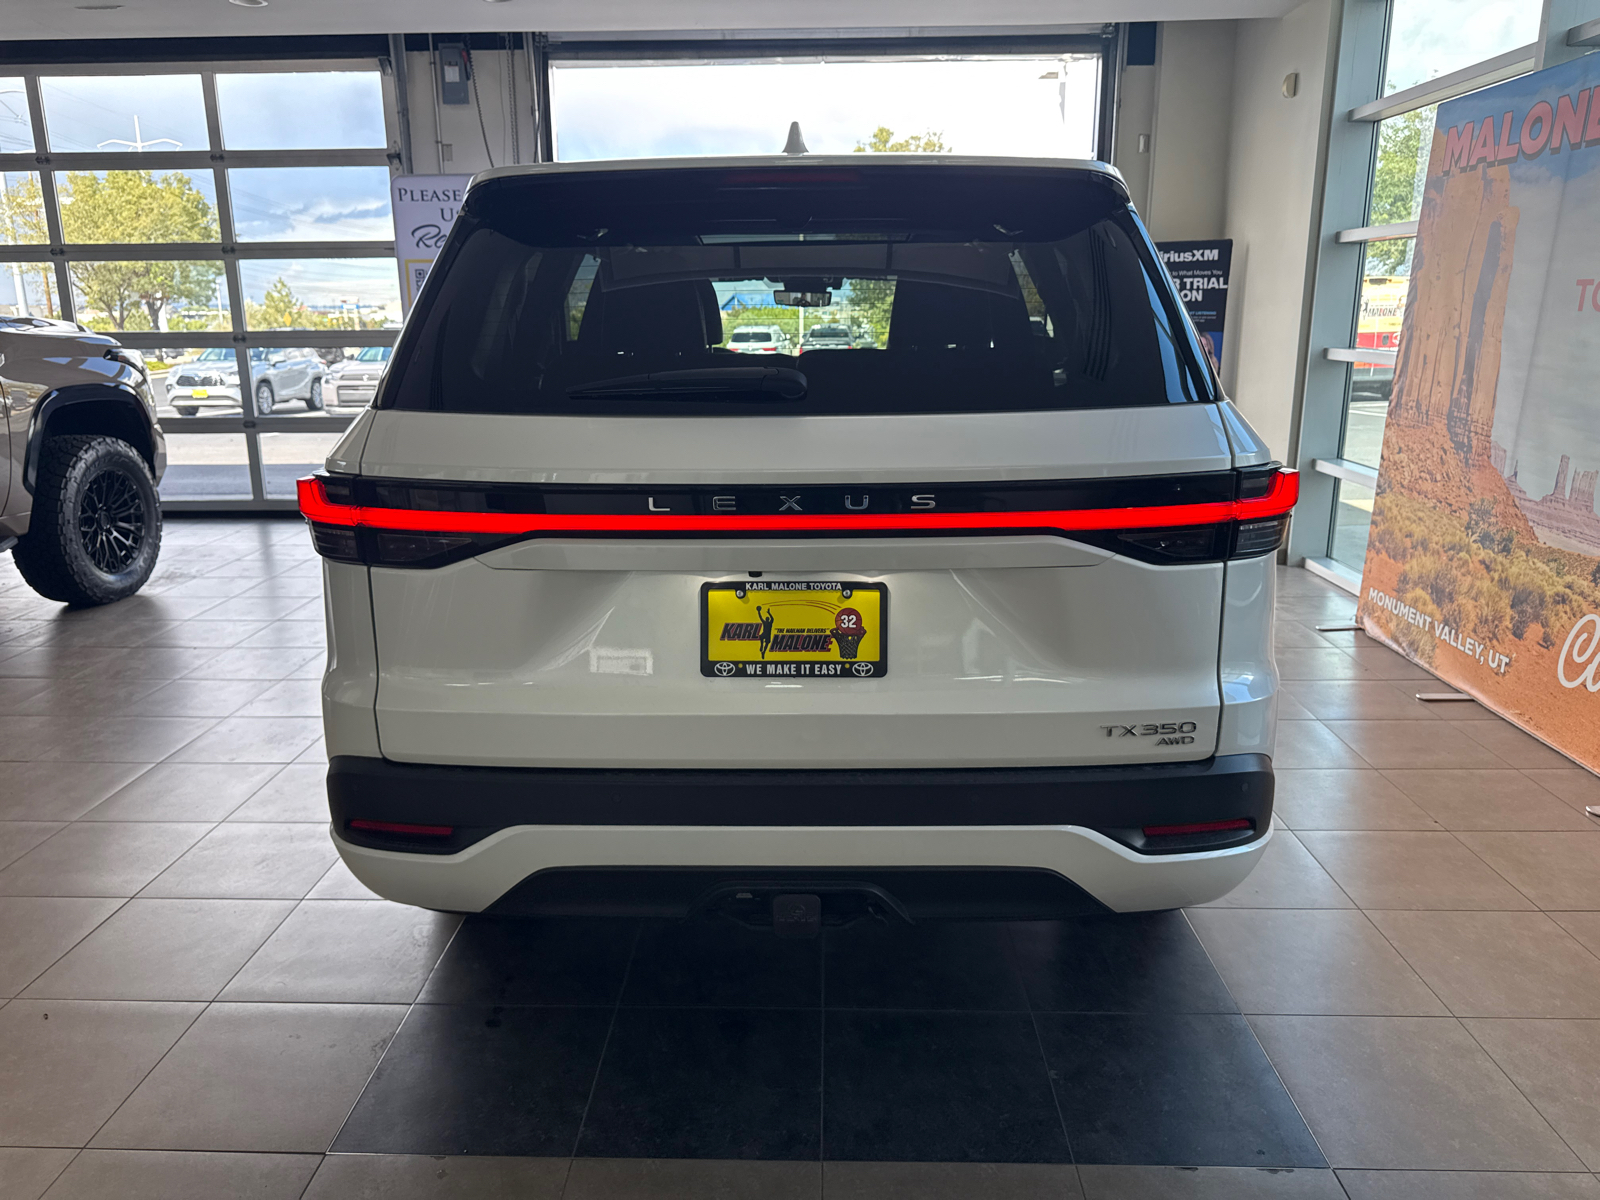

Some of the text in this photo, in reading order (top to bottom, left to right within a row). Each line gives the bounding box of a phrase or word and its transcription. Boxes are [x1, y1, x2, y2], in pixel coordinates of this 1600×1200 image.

[397, 187, 462, 202] PLEASE
[440, 207, 460, 222] U
[411, 224, 447, 248] Re
[1160, 249, 1219, 263] iriusXM
[1183, 277, 1228, 290] TRIAL
[648, 494, 937, 512] LEXUS
[745, 582, 842, 591] KARL MALONE TOYOTA
[840, 615, 857, 629] 32
[720, 622, 763, 641] KARL
[1368, 587, 1510, 674] MONUMENT VALLEY, UT
[769, 633, 833, 653] MALONE
[746, 664, 842, 675] WE MAKE IT EASY
[1155, 735, 1195, 747] AWD
